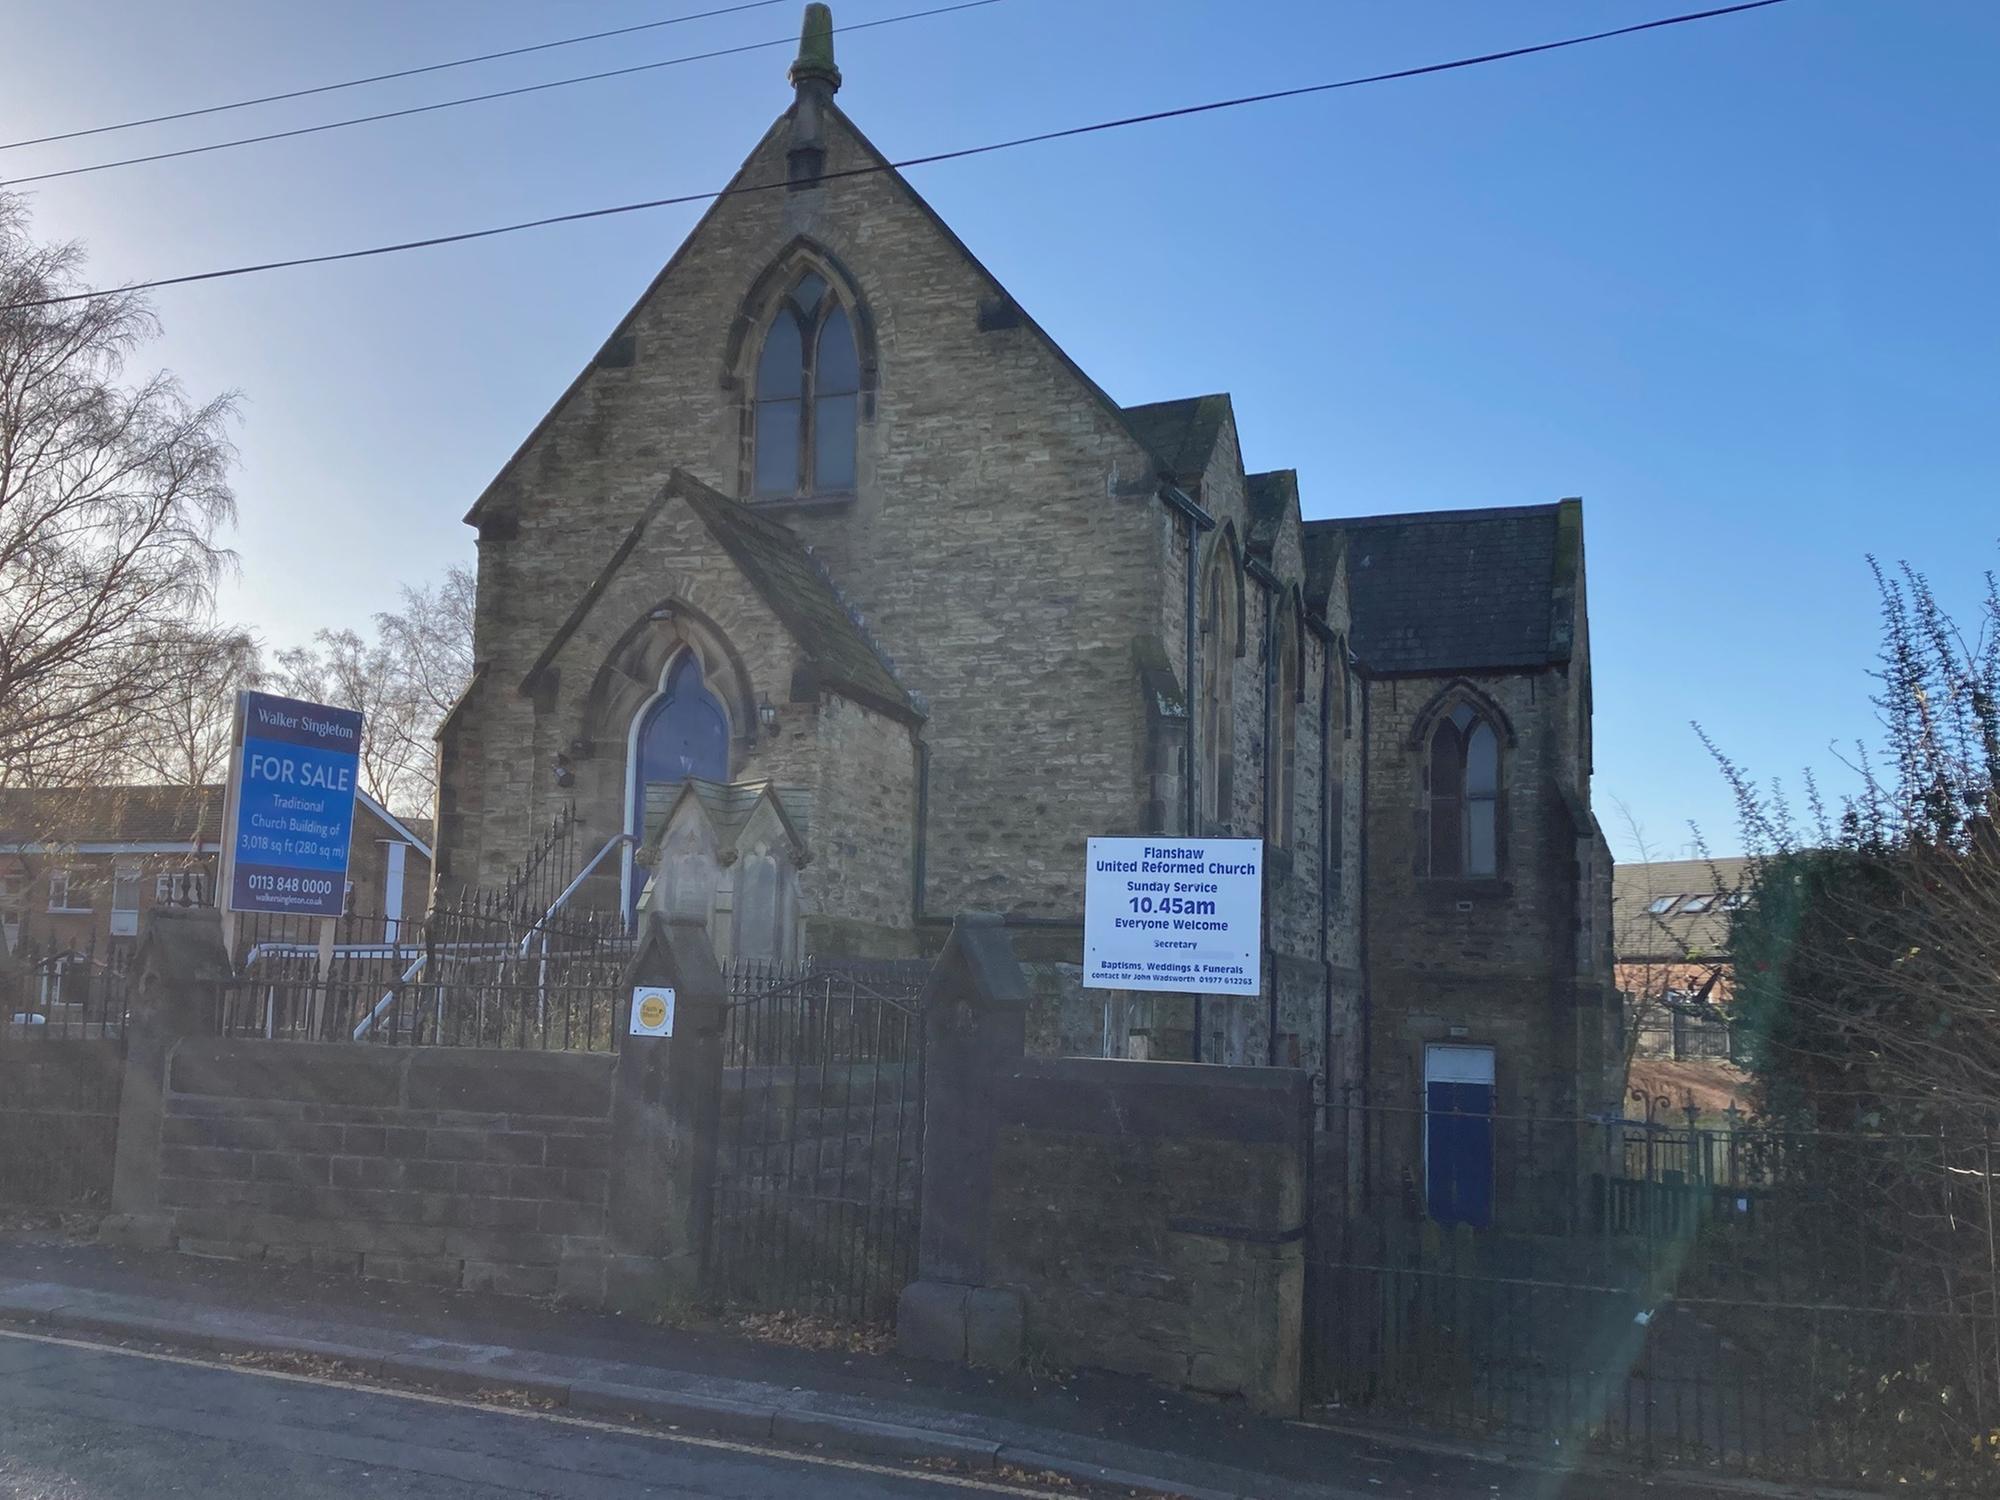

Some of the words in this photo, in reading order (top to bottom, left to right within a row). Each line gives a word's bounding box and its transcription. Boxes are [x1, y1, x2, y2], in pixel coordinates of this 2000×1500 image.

[258, 708, 299, 729] Walker
[301, 718, 353, 739] Singleton
[251, 755, 294, 784] FOR
[301, 763, 349, 791] SALE
[273, 794, 324, 812] Traditional
[252, 814, 286, 830] Church
[289, 818, 328, 837] Building
[330, 824, 340, 835] of
[242, 835, 268, 850] 3,018
[271, 841, 281, 855] sq
[285, 839, 293, 852] ft
[295, 840, 317, 854] (280
[319, 846, 329, 859] sq
[332, 846, 344, 858] m)
[1144, 847, 1204, 859] Flanshaw
[1097, 861, 1137, 873] United
[1142, 861, 1204, 874] Reformed
[1209, 863, 1255, 875] Church
[249, 874, 273, 890] 0113
[277, 877, 299, 892] 848
[302, 880, 331, 894] 0000
[1127, 881, 1170, 893] Sunday
[1174, 882, 1217, 893] Service
[256, 893, 322, 905] walkersingleton.co.uk
[1129, 897, 1216, 915] 10.45am
[1115, 918, 1169, 930] Everyone
[1173, 920, 1228, 931] Welcome
[1154, 940, 1197, 950] Secretary
[1102, 961, 1144, 971] Baptisms,
[1148, 963, 1191, 973] Weddings
[1203, 965, 1243, 974] Funerals
